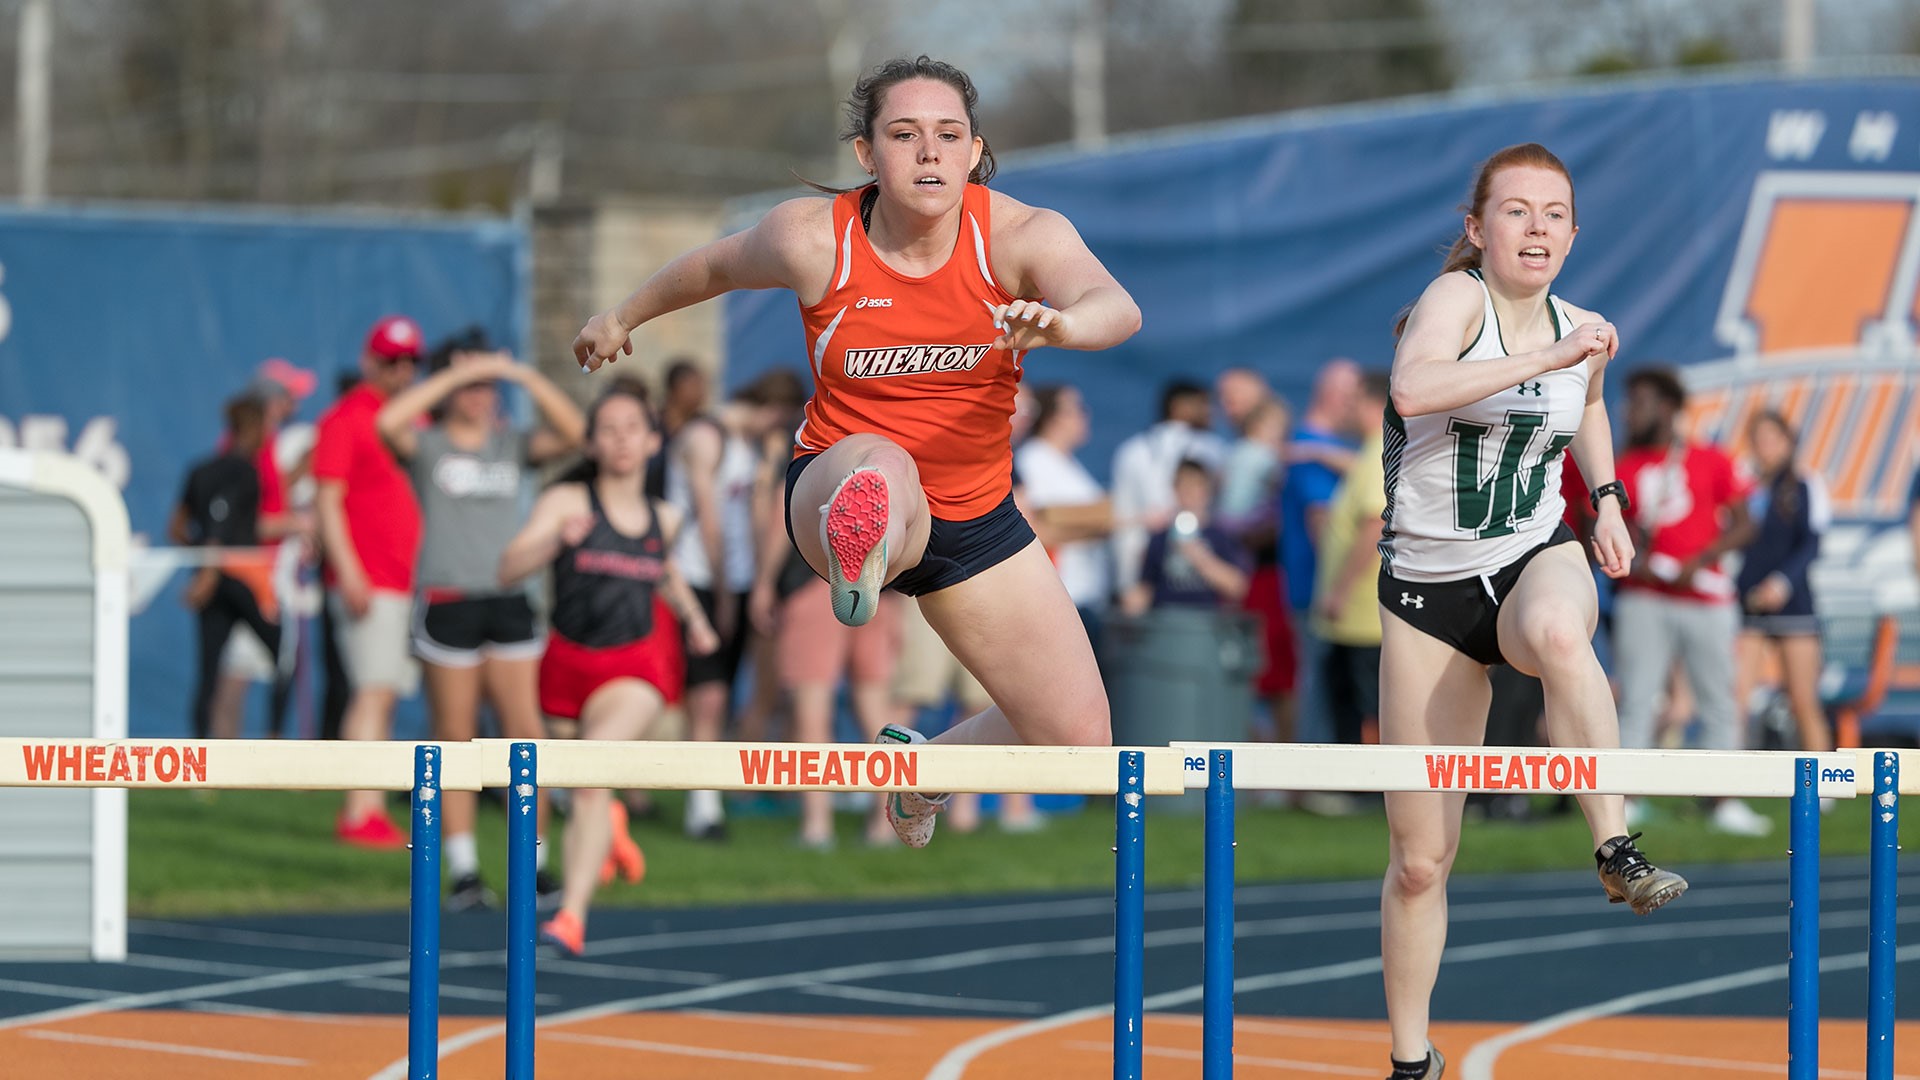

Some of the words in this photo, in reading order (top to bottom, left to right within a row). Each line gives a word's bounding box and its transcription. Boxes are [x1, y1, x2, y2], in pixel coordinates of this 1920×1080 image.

[867, 298, 892, 308] asics
[844, 344, 993, 379] WHEATON
[22, 745, 207, 782] WHEATON
[739, 750, 917, 787] WHEATON
[1425, 754, 1597, 791] WHEATON
